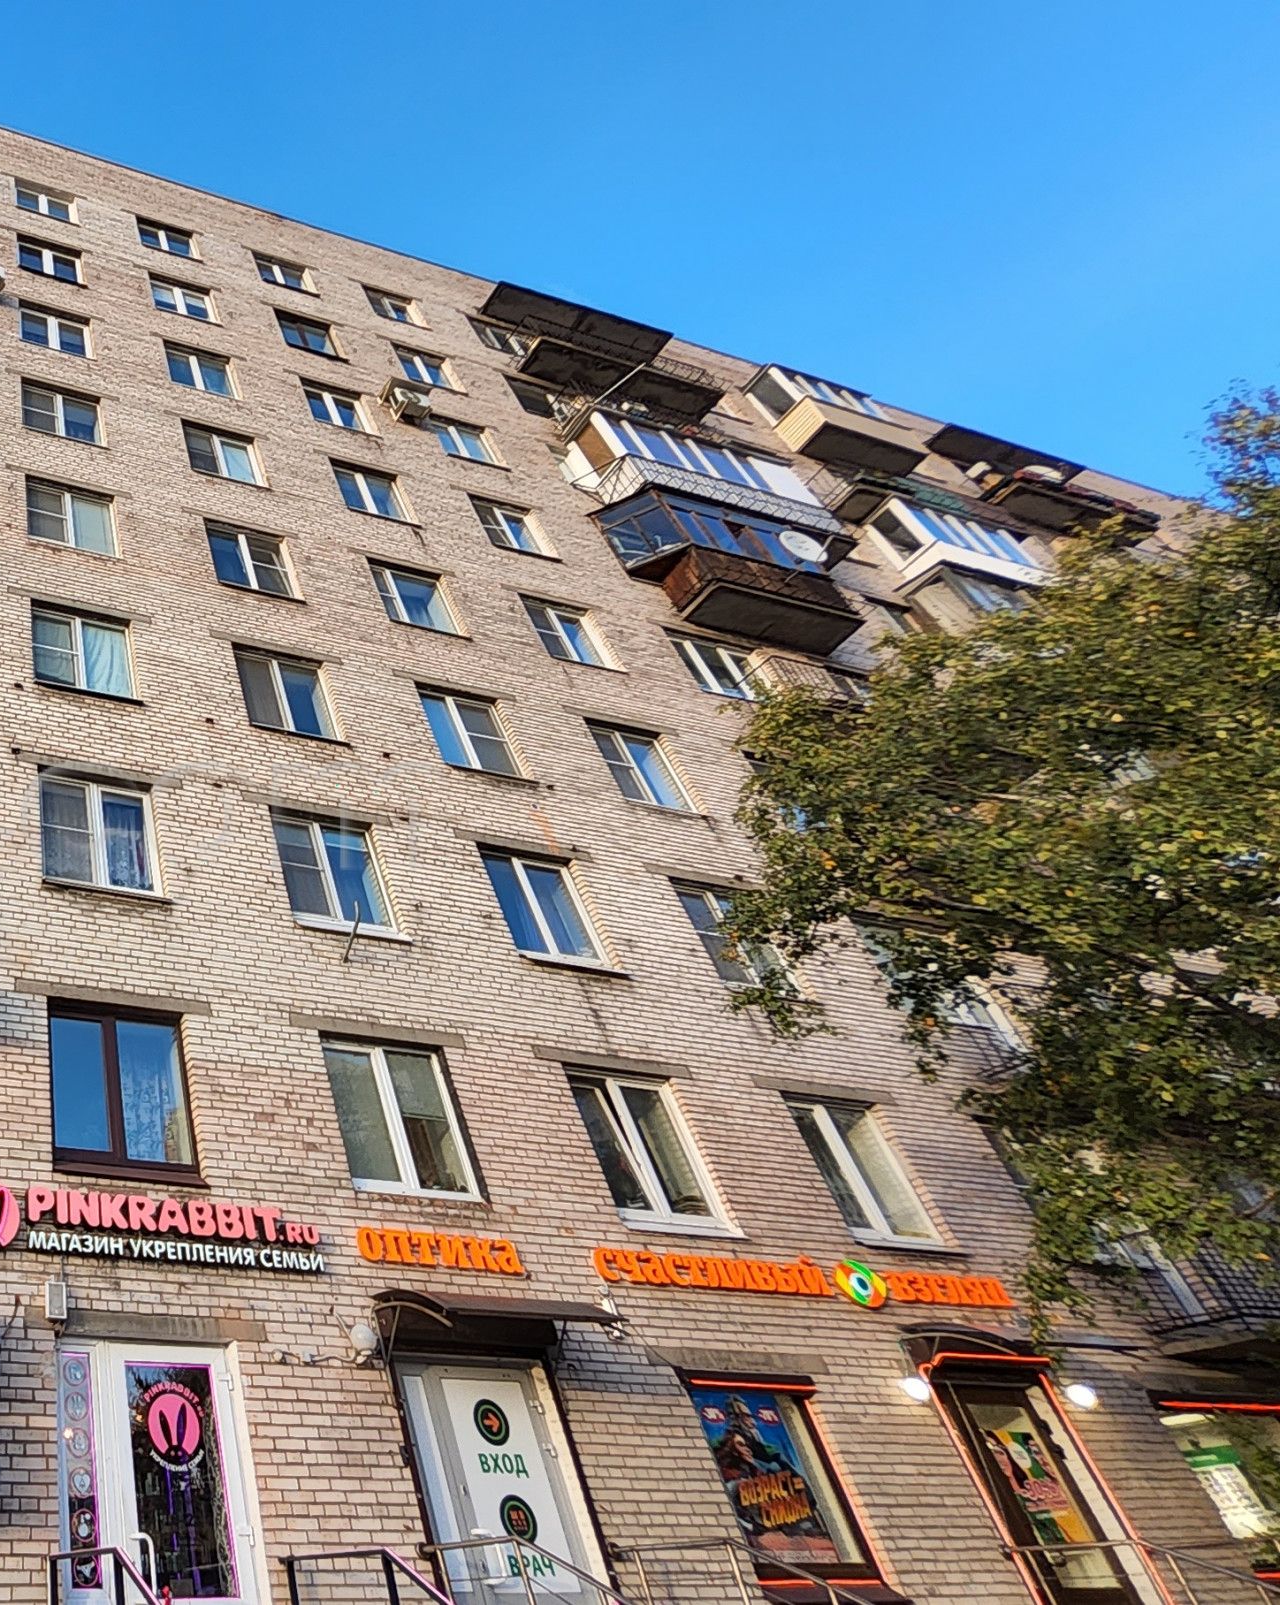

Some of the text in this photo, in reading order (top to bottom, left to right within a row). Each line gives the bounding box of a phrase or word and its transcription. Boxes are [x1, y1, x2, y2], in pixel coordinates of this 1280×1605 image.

[28, 1231, 325, 1272] МАГАЗИН УКРЕПЛЕНИЯ СЕМЬИ
[478, 1452, 531, 1480] ВХОД
